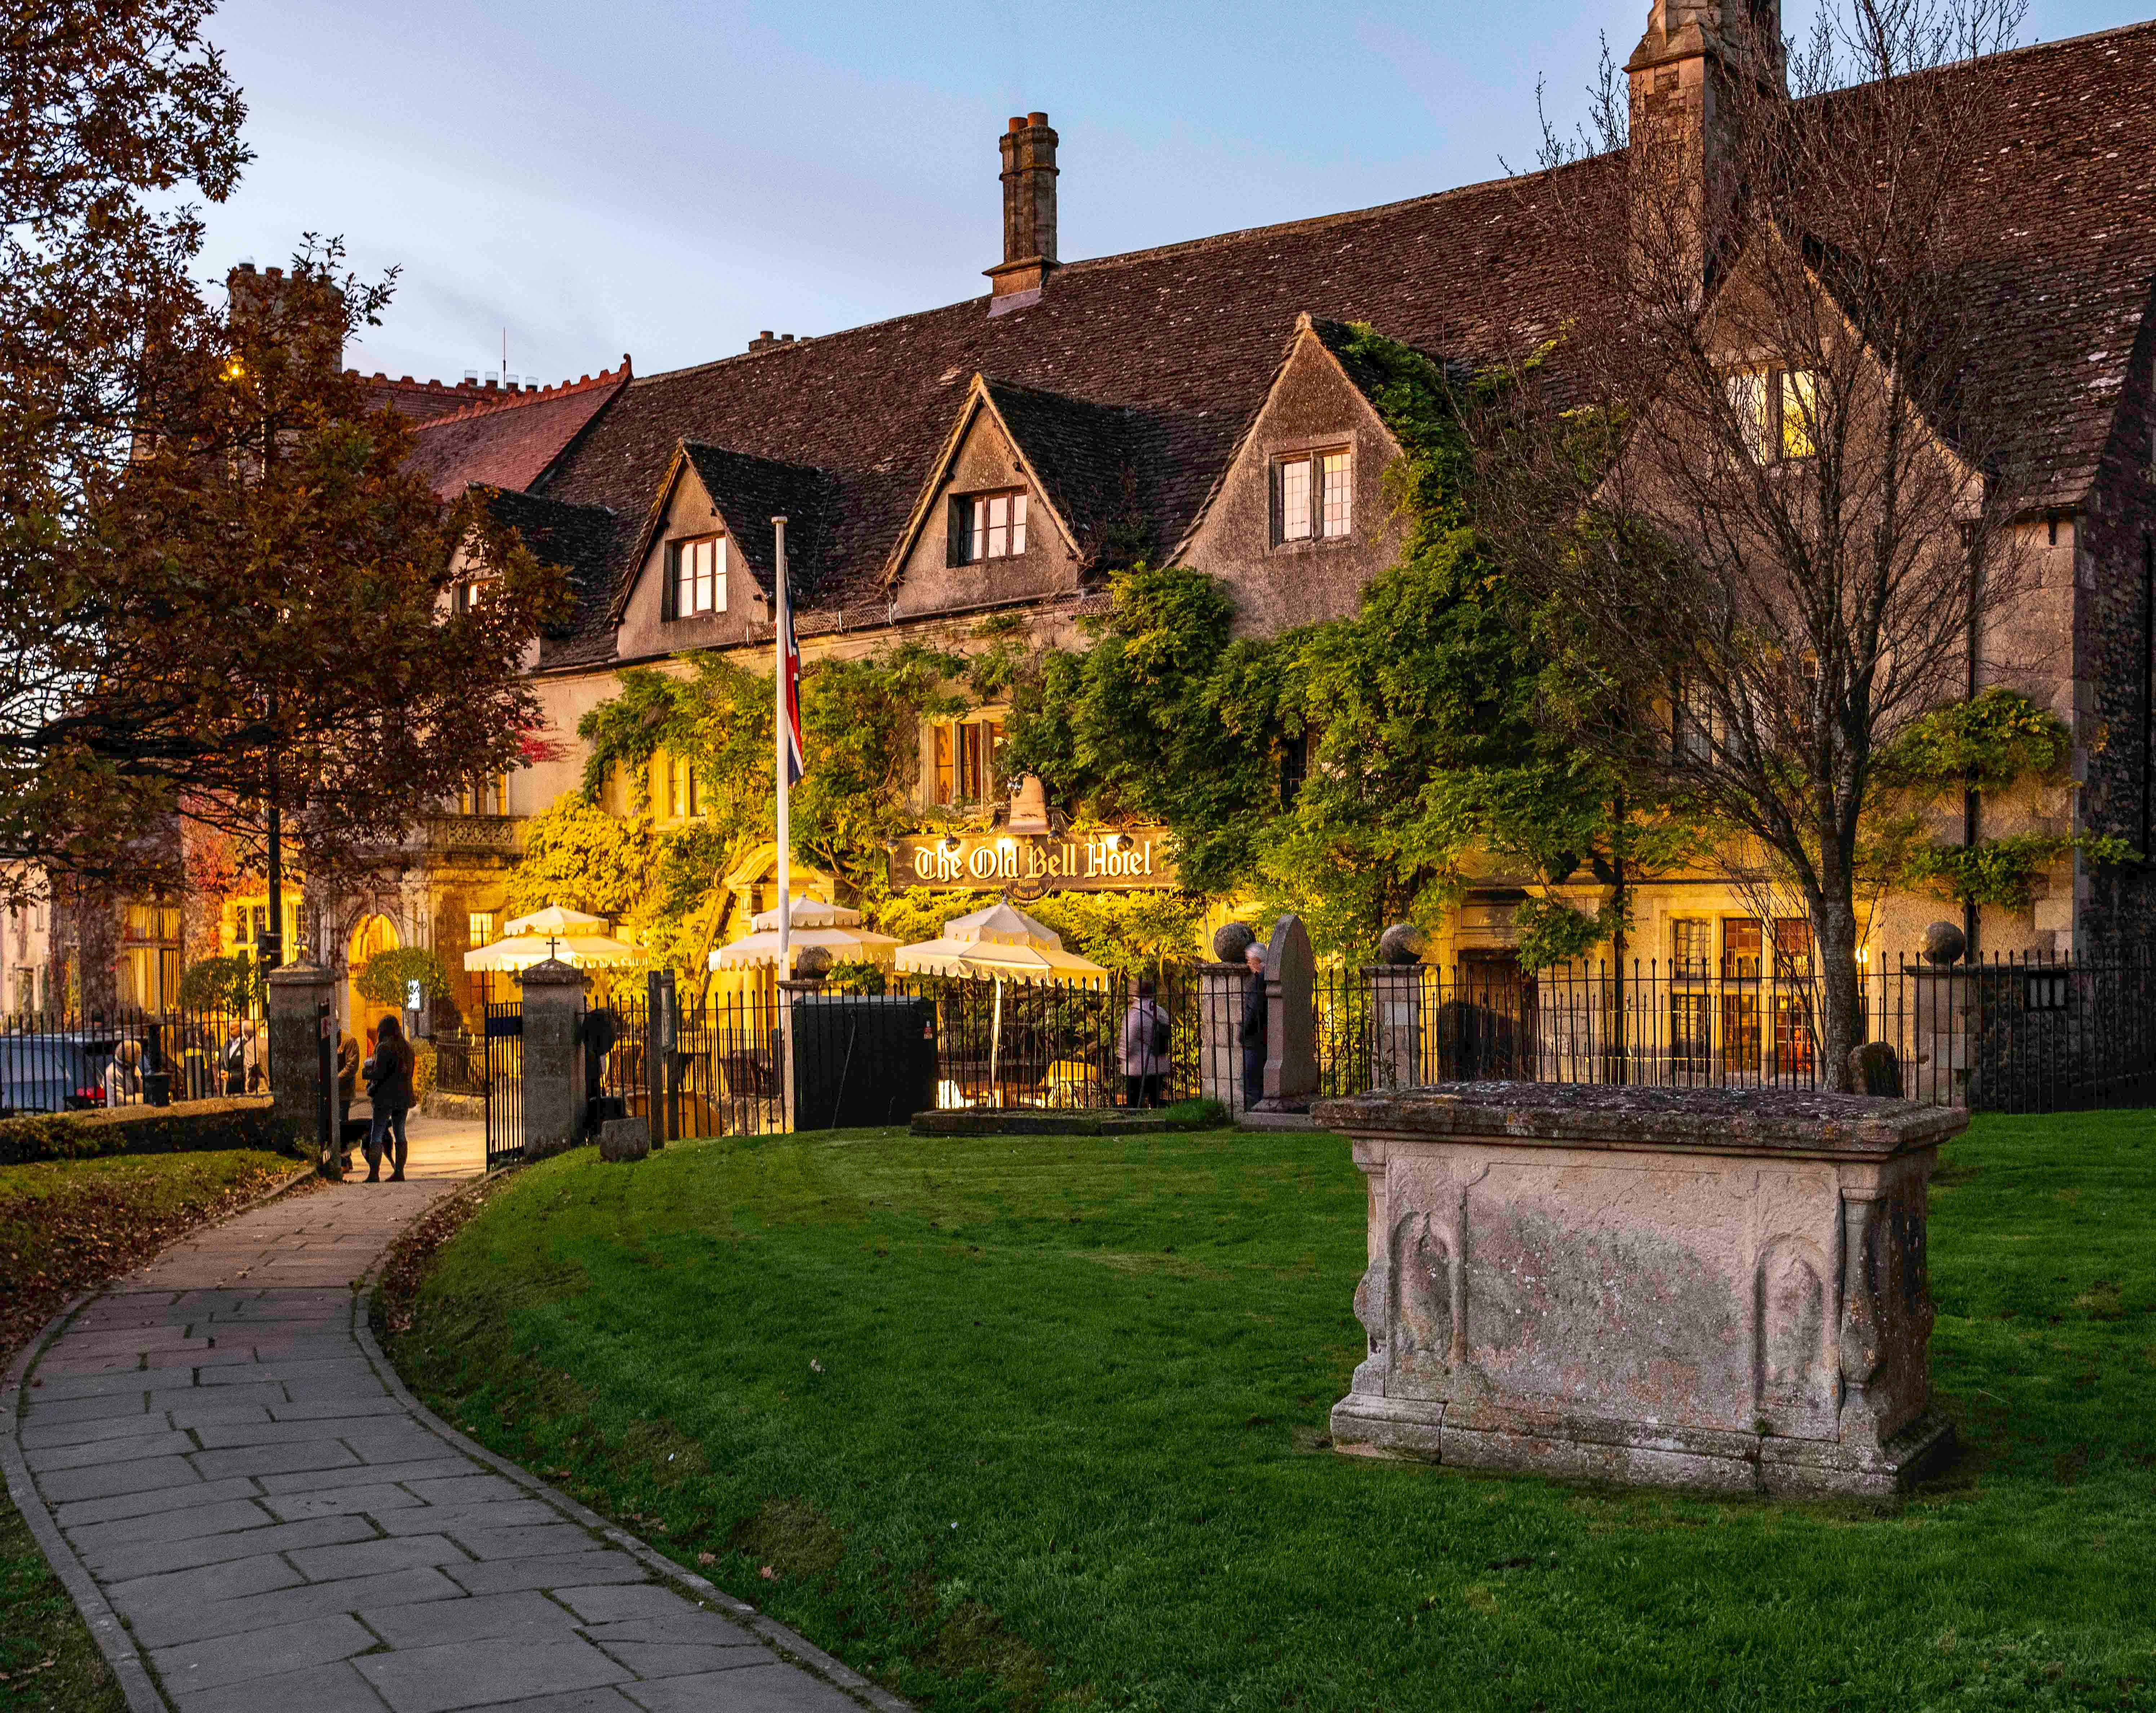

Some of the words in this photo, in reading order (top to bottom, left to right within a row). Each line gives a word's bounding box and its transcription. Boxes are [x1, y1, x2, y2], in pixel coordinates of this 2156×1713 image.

[914, 845, 963, 882] The
[969, 846, 1020, 879] Old
[1025, 842, 1078, 879] Bell
[1084, 841, 1152, 879] Hotel
